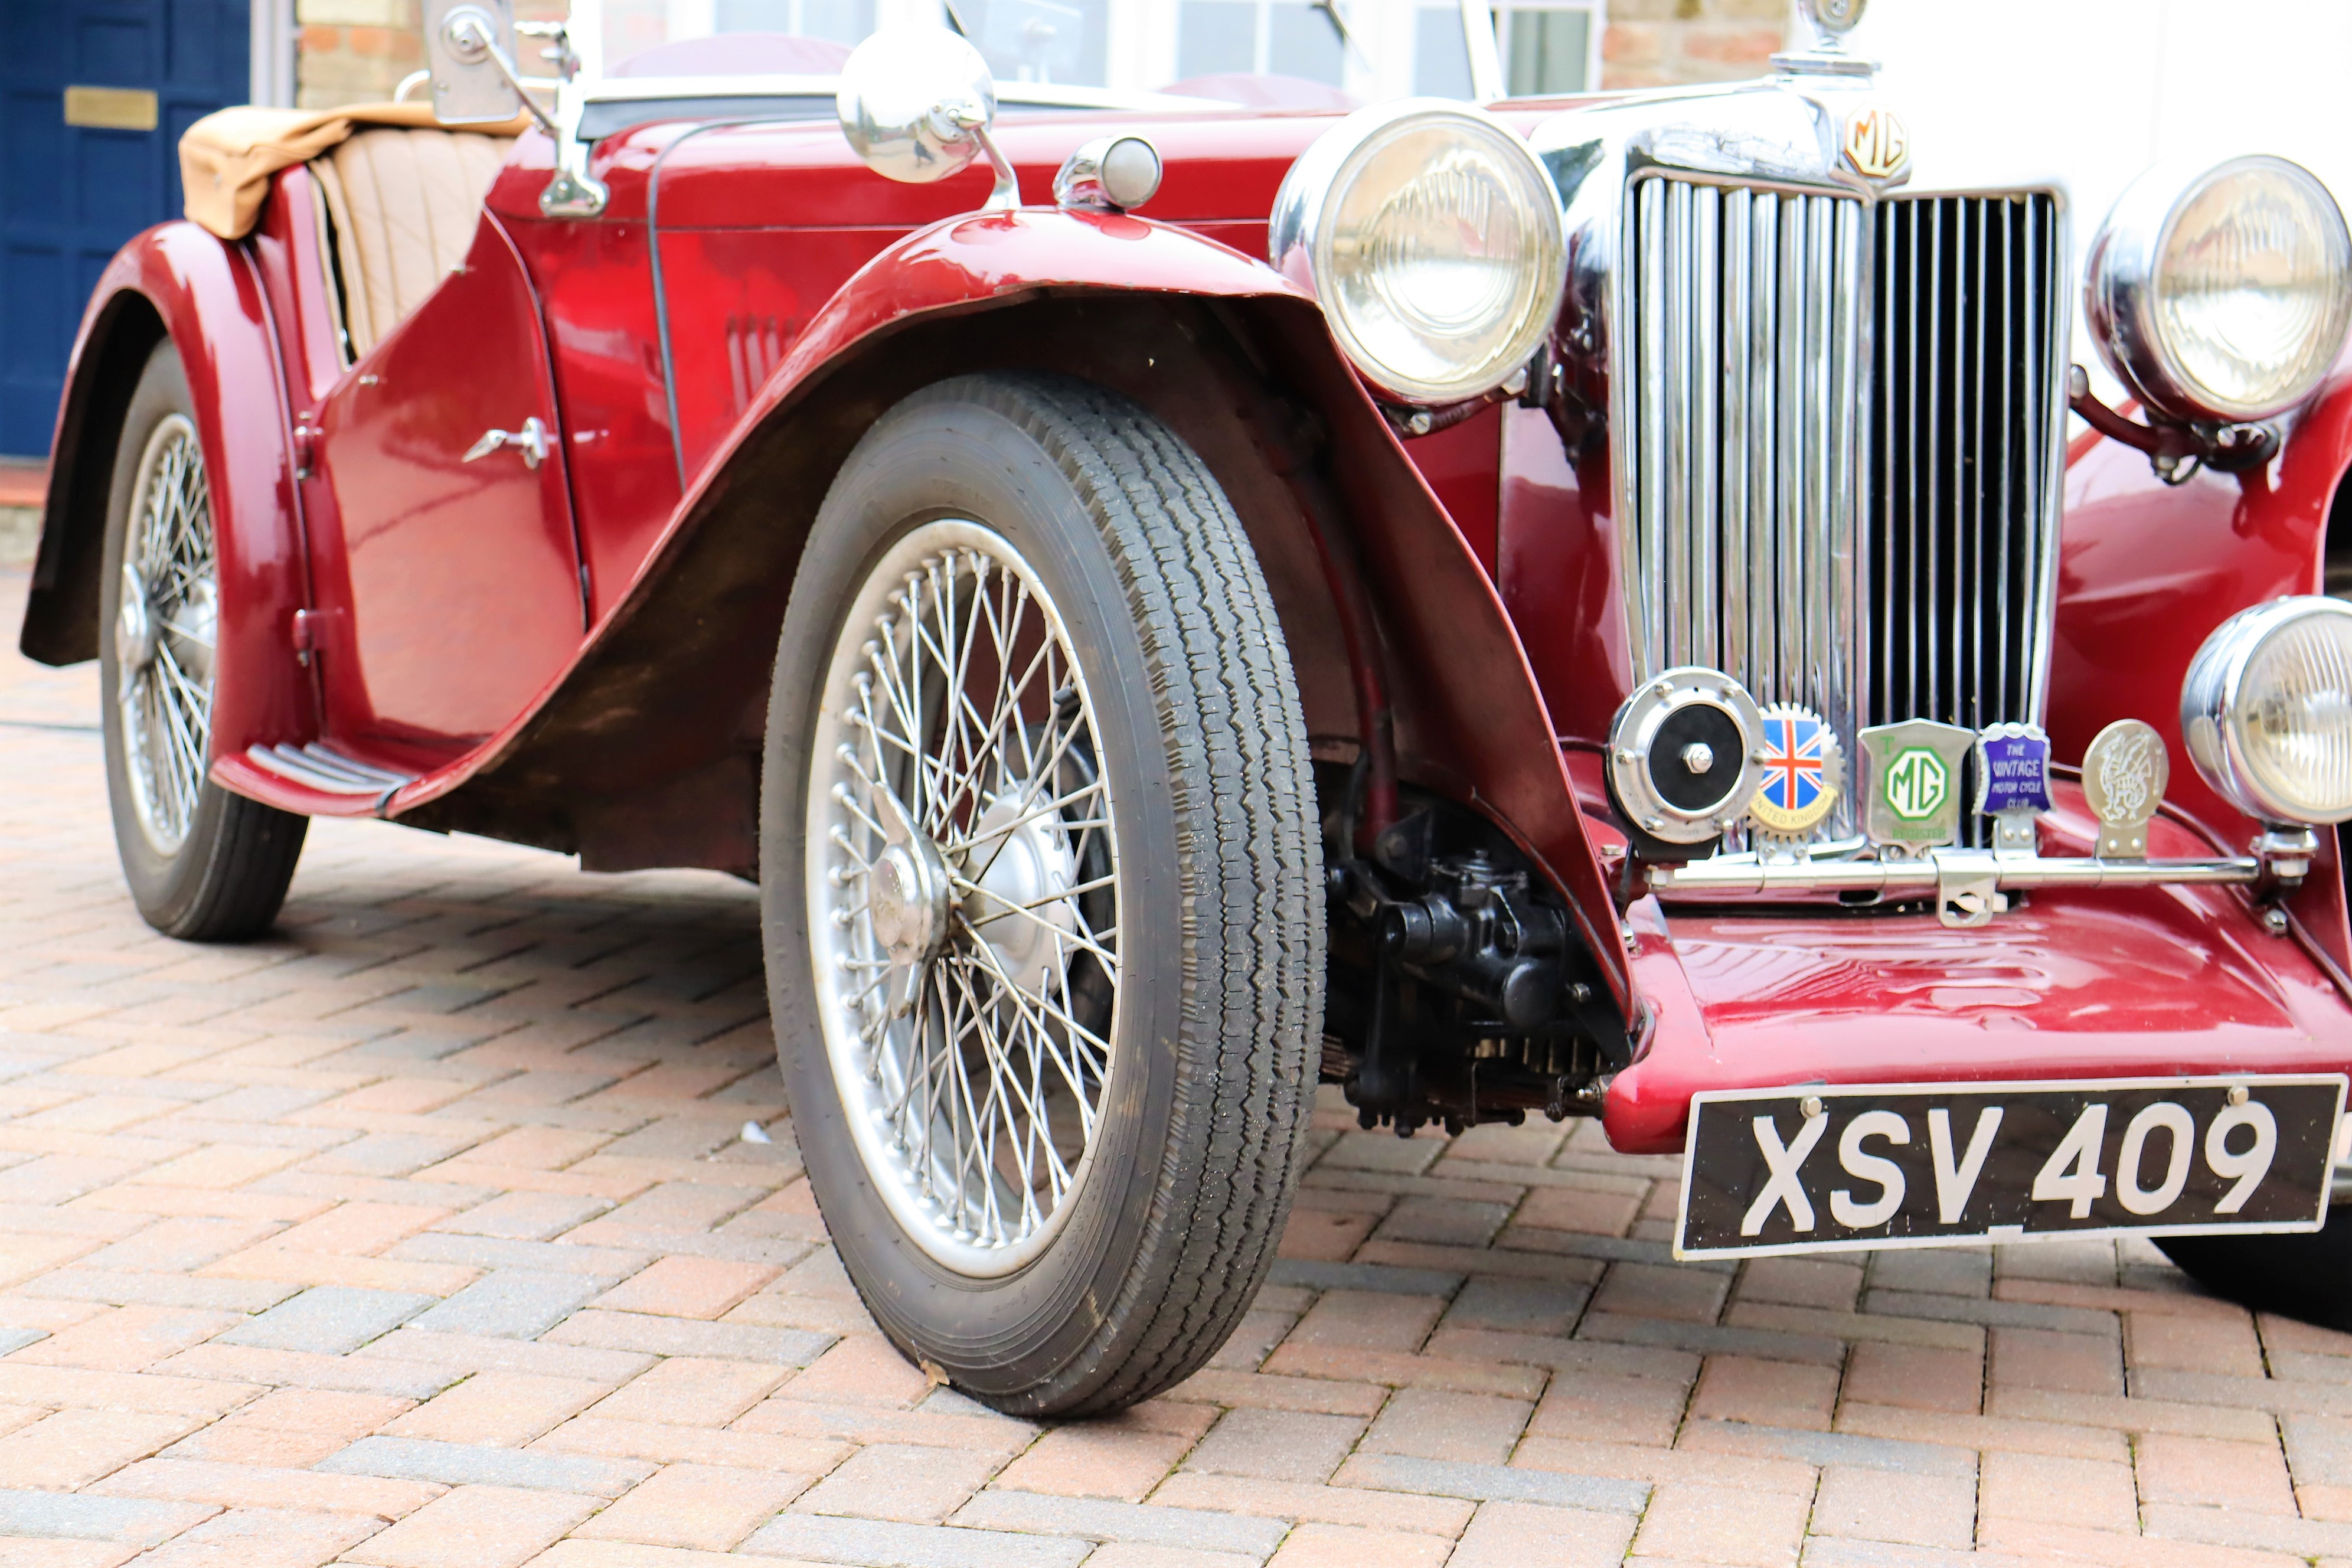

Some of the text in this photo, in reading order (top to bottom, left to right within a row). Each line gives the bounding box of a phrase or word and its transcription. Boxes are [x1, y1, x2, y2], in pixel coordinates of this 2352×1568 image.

[1854, 110, 1903, 168] MG
[1880, 736, 1895, 755] T
[2007, 743, 2026, 756] THE
[1992, 759, 2040, 778] VINTAGE
[1893, 757, 1939, 811] MG
[1991, 780, 2041, 793] MOTOR CYCLE
[1791, 793, 1830, 825] KINGDOM
[1740, 1100, 2278, 1237] XSV 409
